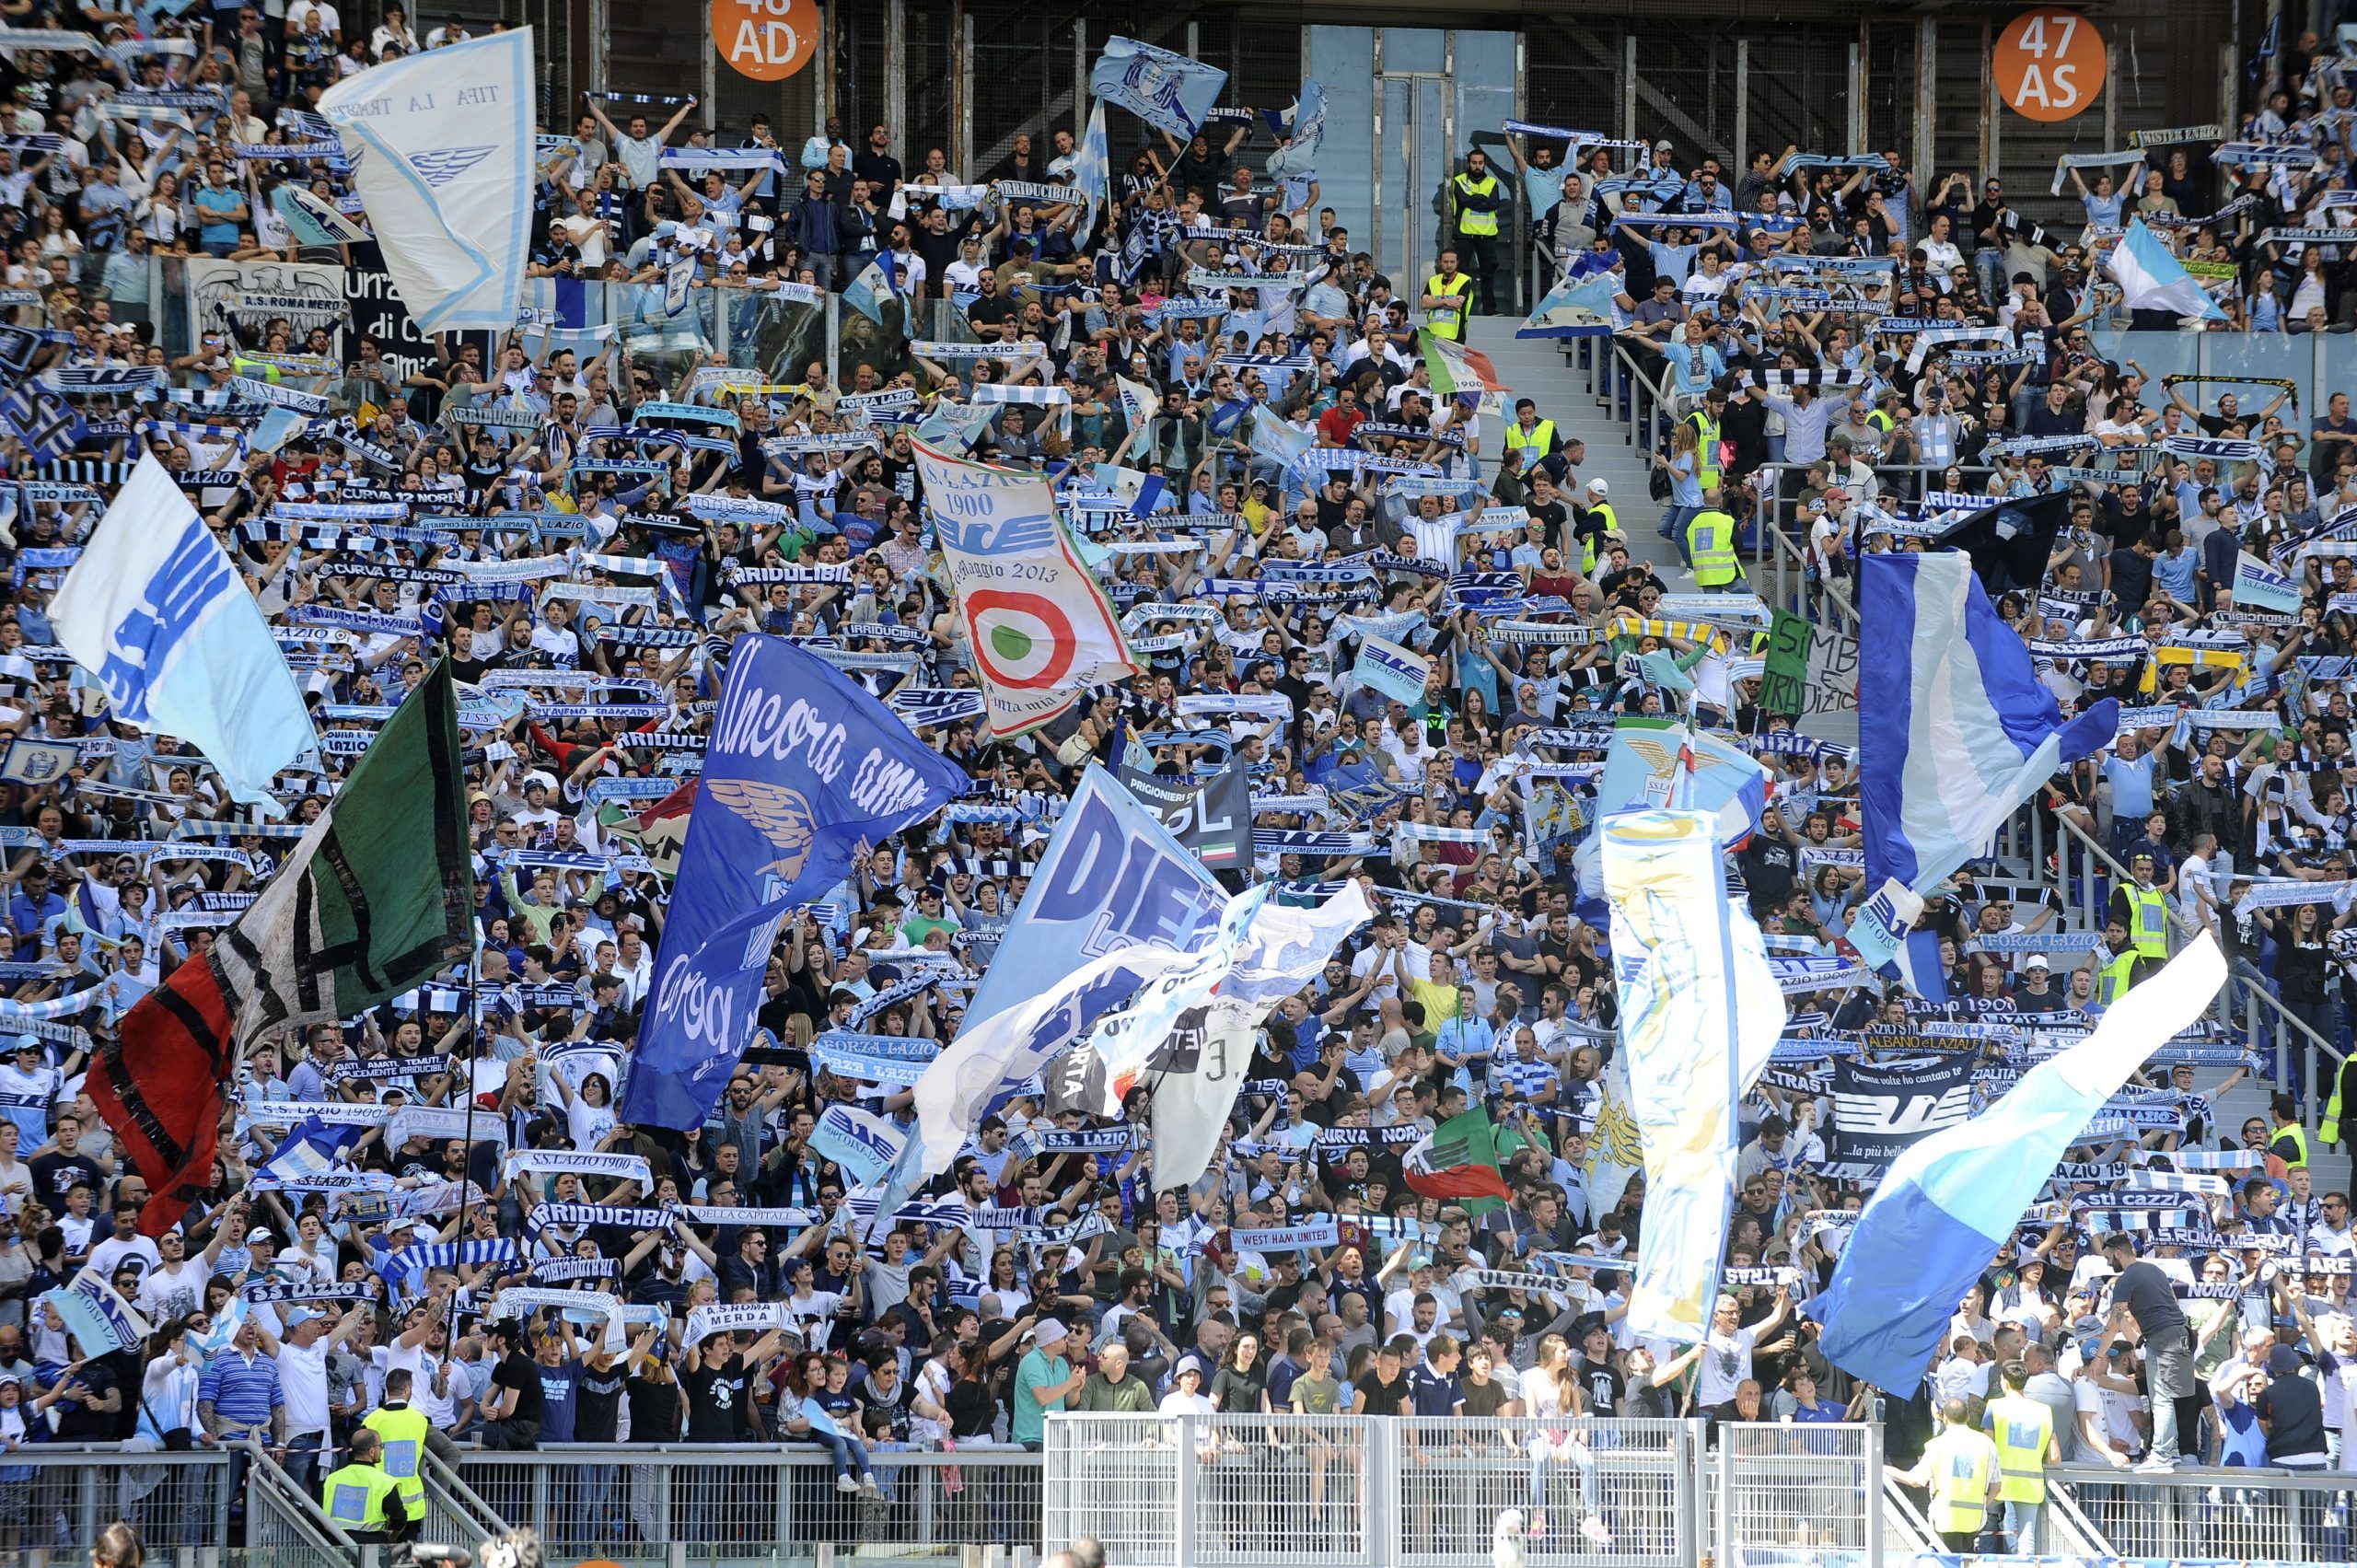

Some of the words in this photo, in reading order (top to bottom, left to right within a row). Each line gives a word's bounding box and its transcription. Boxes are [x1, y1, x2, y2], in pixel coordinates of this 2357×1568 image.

[730, 19, 796, 64] AD
[2019, 17, 2076, 59] 47
[2014, 64, 2077, 107] AS
[302, 140, 340, 154] LAZIO
[244, 296, 267, 307] A.S.
[270, 296, 305, 308] ROMA
[308, 297, 348, 309] MERDA
[1886, 319, 1921, 328] FORZA
[1922, 319, 1958, 329] LAZIO
[970, 344, 1015, 354] LAZIO
[1456, 380, 1483, 389] 1900
[839, 394, 878, 408] FORZA
[881, 388, 915, 405] LAZIO
[1358, 422, 1409, 433] FORZA
[1411, 426, 1464, 444] LAIO
[343, 429, 395, 461] LAZIO
[2005, 437, 2050, 451] FORZA
[180, 472, 233, 484] LAZIO
[2070, 469, 2118, 479] LAZIO
[341, 489, 392, 501] CURVA
[394, 492, 414, 503] 12
[416, 492, 456, 504] NORD
[945, 492, 994, 517] 1900
[546, 520, 584, 530] LAZIO
[335, 563, 382, 578] CURVA
[388, 565, 409, 579] 12
[411, 571, 454, 583] NORD
[1013, 563, 1059, 583] 2013
[1287, 571, 1355, 580] LAZIO
[2040, 585, 2090, 603] LAZIO
[320, 609, 360, 623] VOLA
[621, 626, 693, 645] LAZIO
[851, 624, 926, 640] IRRIDUCIBILI
[1492, 628, 1584, 643] IRRIDUCIBILI
[1137, 637, 1166, 649] LAZIO
[540, 706, 587, 716] V'AVEMO
[596, 706, 649, 716] SBANCATO
[329, 740, 368, 753] LAZIO
[1130, 778, 1186, 804] PRIGIONIERI
[1290, 845, 1352, 855] COMBATTIAMO
[1988, 935, 2044, 948] FORZA
[2049, 935, 2097, 948] LAZIO
[824, 1039, 882, 1054] FORZA
[887, 1039, 937, 1056] LAZIO
[1869, 1036, 1920, 1049] ALBANO
[1930, 1037, 1982, 1051] LAZIALE
[400, 1063, 447, 1077] IRRIDUCIBILI
[1851, 1069, 1877, 1085] Quante
[1879, 1070, 1900, 1086] volte
[1901, 1070, 1912, 1085] ho
[1914, 1065, 1951, 1084] cantato
[1952, 1065, 1962, 1078] te
[297, 1105, 343, 1116] LAZIO
[346, 1107, 383, 1118] 1900
[1048, 1133, 1076, 1146] S.S.
[1083, 1132, 1127, 1146] LAZIO
[1864, 1144, 1889, 1159] più
[601, 1157, 632, 1170] 1900
[2088, 1192, 2117, 1206] sti
[2123, 1191, 2180, 1206] cazzi
[698, 1209, 734, 1220] DELLA
[737, 1208, 794, 1221] CAPITALE
[1241, 1233, 1270, 1247] WEST
[1271, 1231, 1295, 1245] HAM
[1296, 1228, 1329, 1244] UNITED
[2177, 1229, 2223, 1245] ROMA
[2309, 1255, 2351, 1274] ARE
[1478, 1270, 1569, 1293] ULTRAS
[252, 1285, 285, 1301] S.S.
[712, 1310, 769, 1323] MERDA
